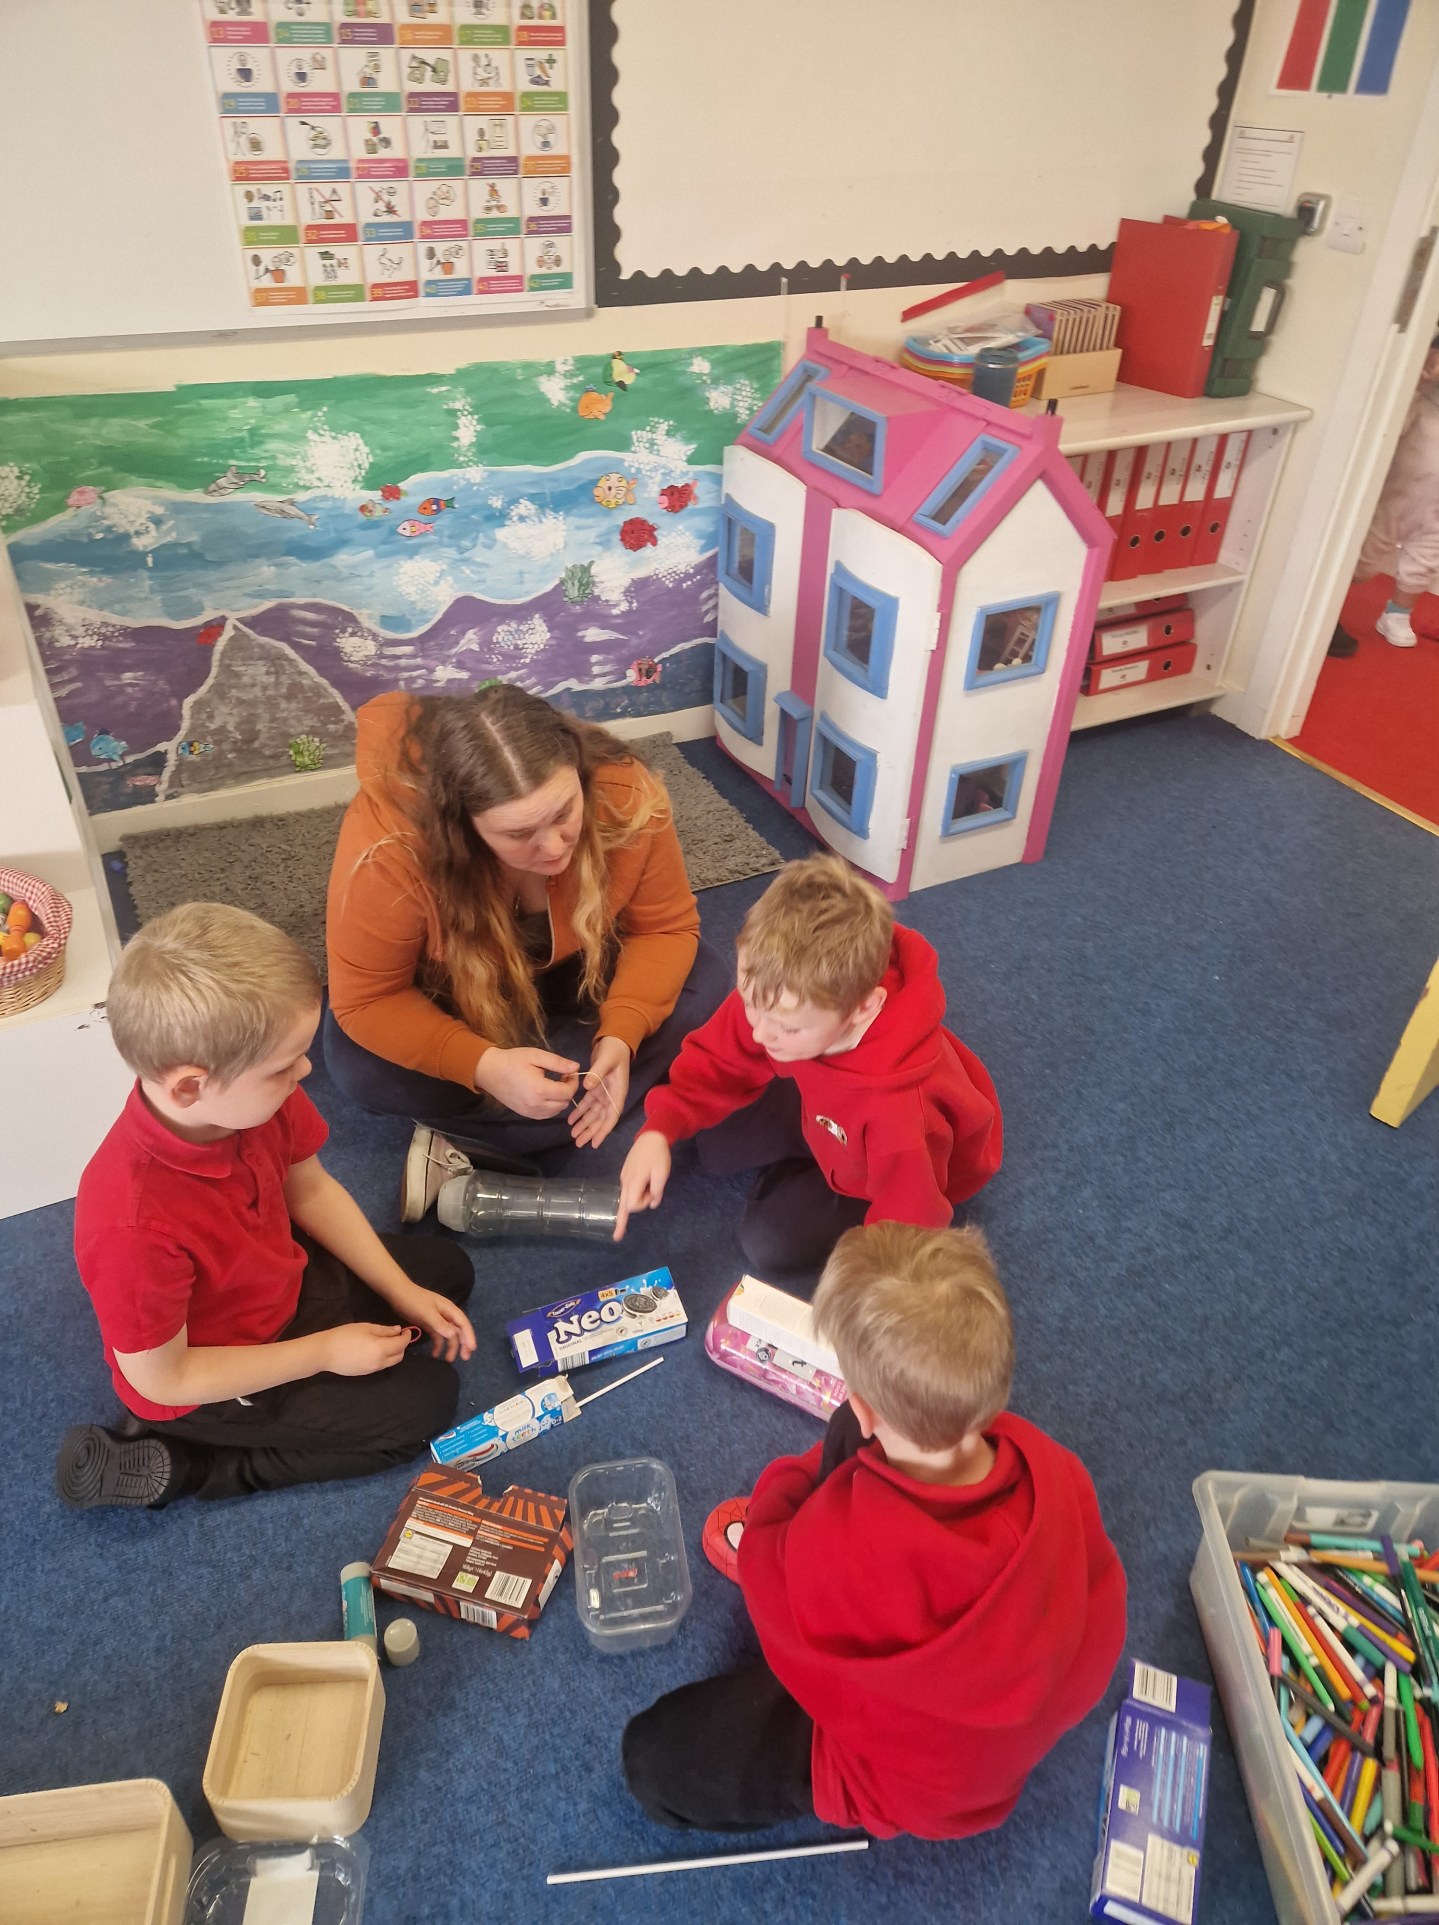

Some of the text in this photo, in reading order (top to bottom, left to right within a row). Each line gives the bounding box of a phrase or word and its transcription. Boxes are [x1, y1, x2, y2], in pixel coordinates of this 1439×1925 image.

[555, 1300, 623, 1342] Neo
[512, 1428, 537, 1441] teeth
[514, 1424, 531, 1436] milk
